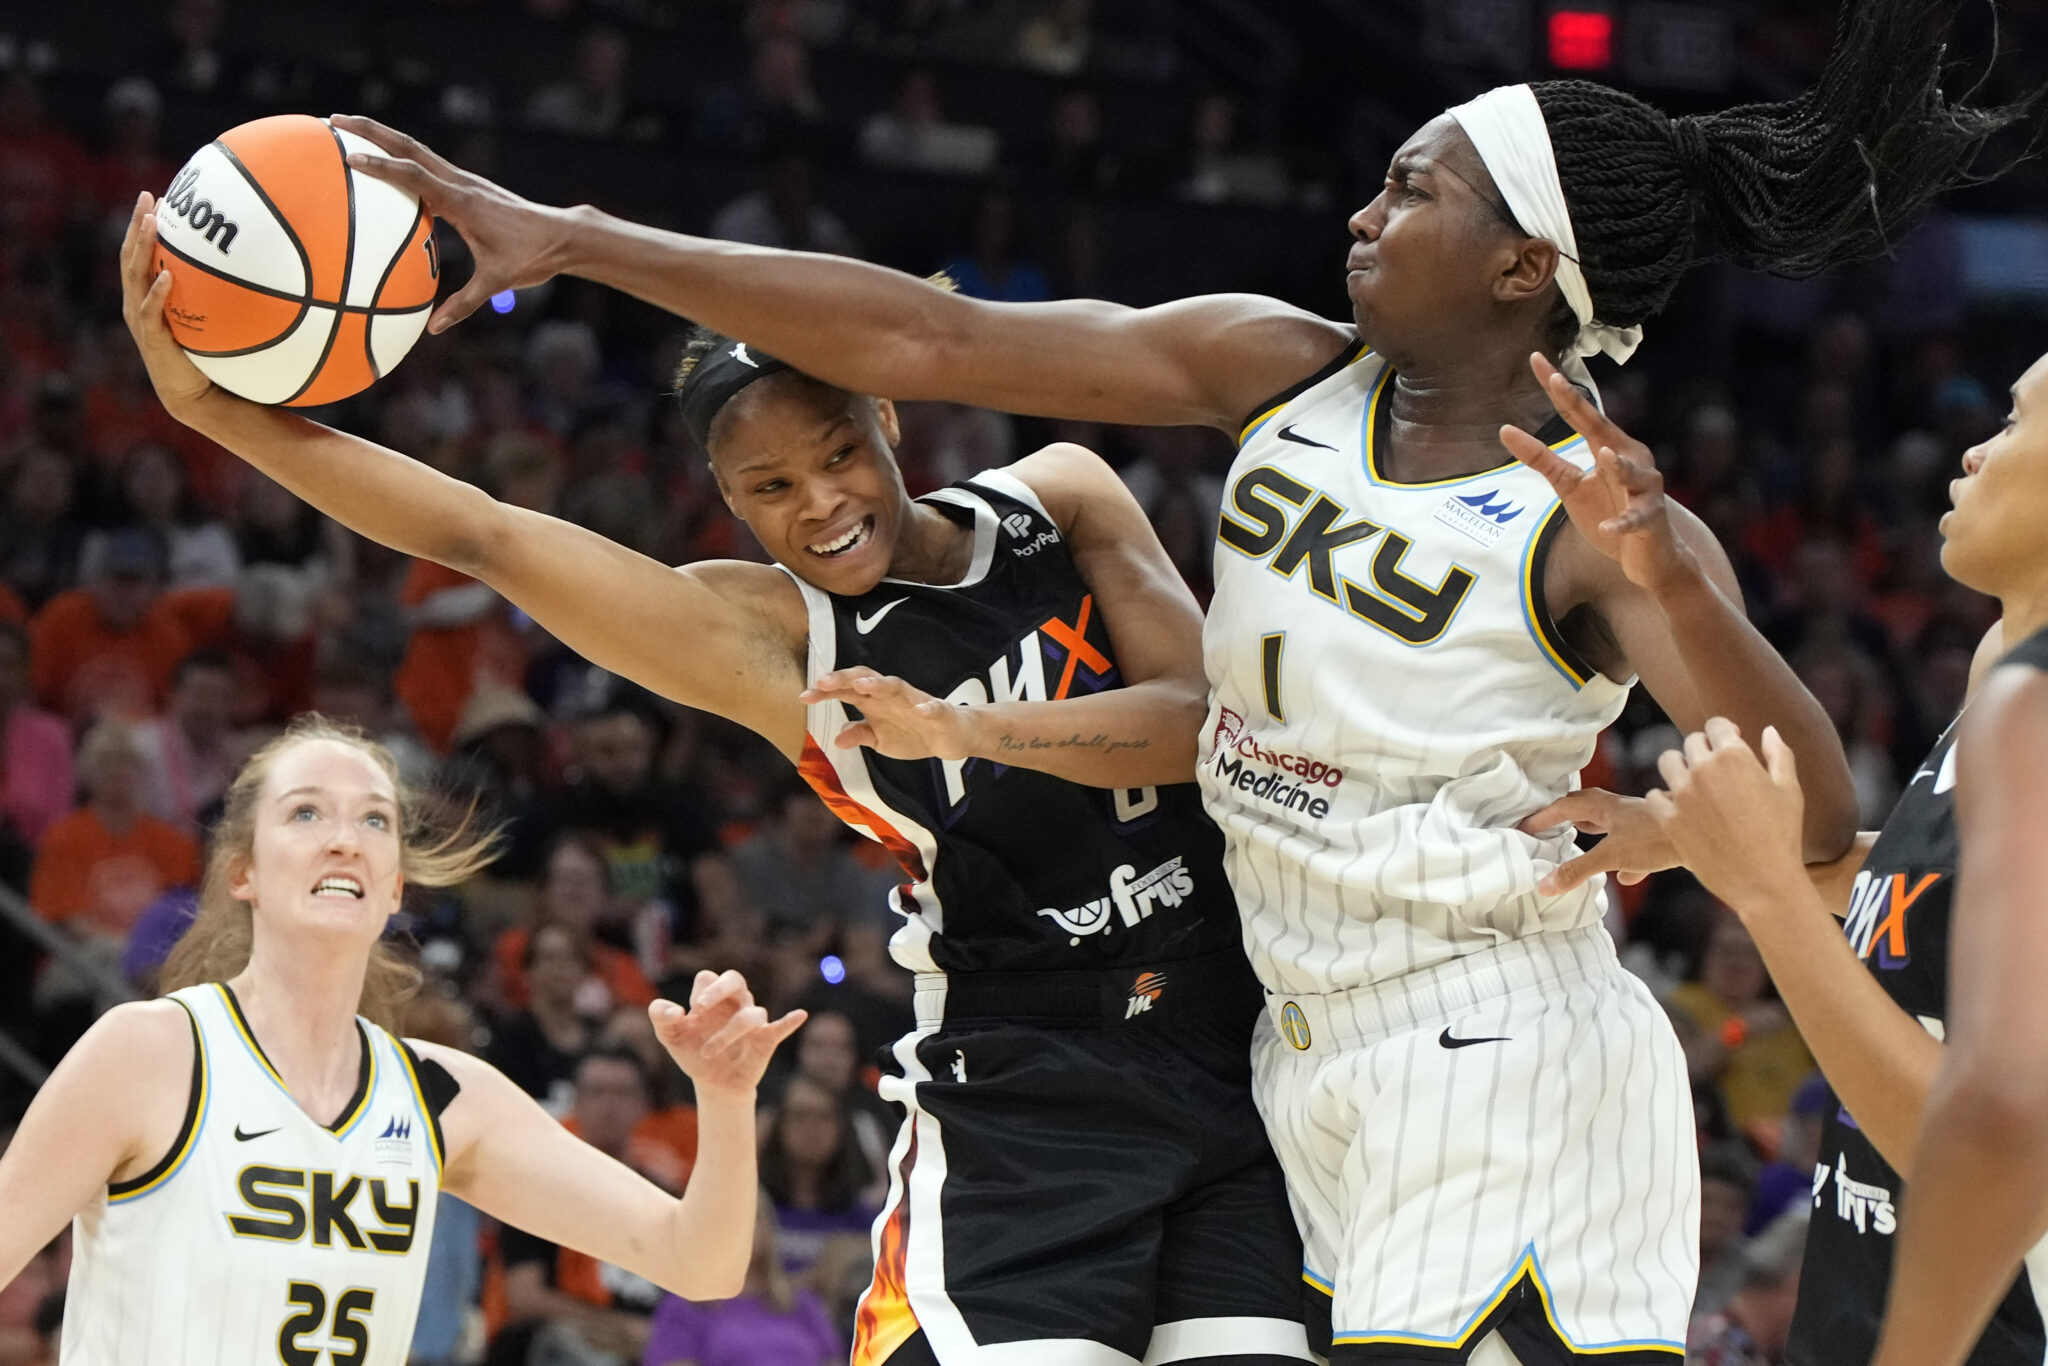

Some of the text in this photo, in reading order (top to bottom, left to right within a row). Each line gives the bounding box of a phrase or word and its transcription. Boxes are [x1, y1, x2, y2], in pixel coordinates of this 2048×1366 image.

[166, 165, 240, 258] ilson
[1011, 528, 1060, 558] PayPal
[1442, 499, 1501, 538] MAGELLAN
[1217, 464, 1480, 648] SKY
[997, 733, 1025, 751] This
[1030, 737, 1051, 749] too
[1057, 734, 1108, 748] shall
[1237, 735, 1343, 788] Chicago
[1215, 752, 1329, 820] Medicine
[223, 1165, 420, 1256] SKY
[276, 1279, 376, 1366] 25
